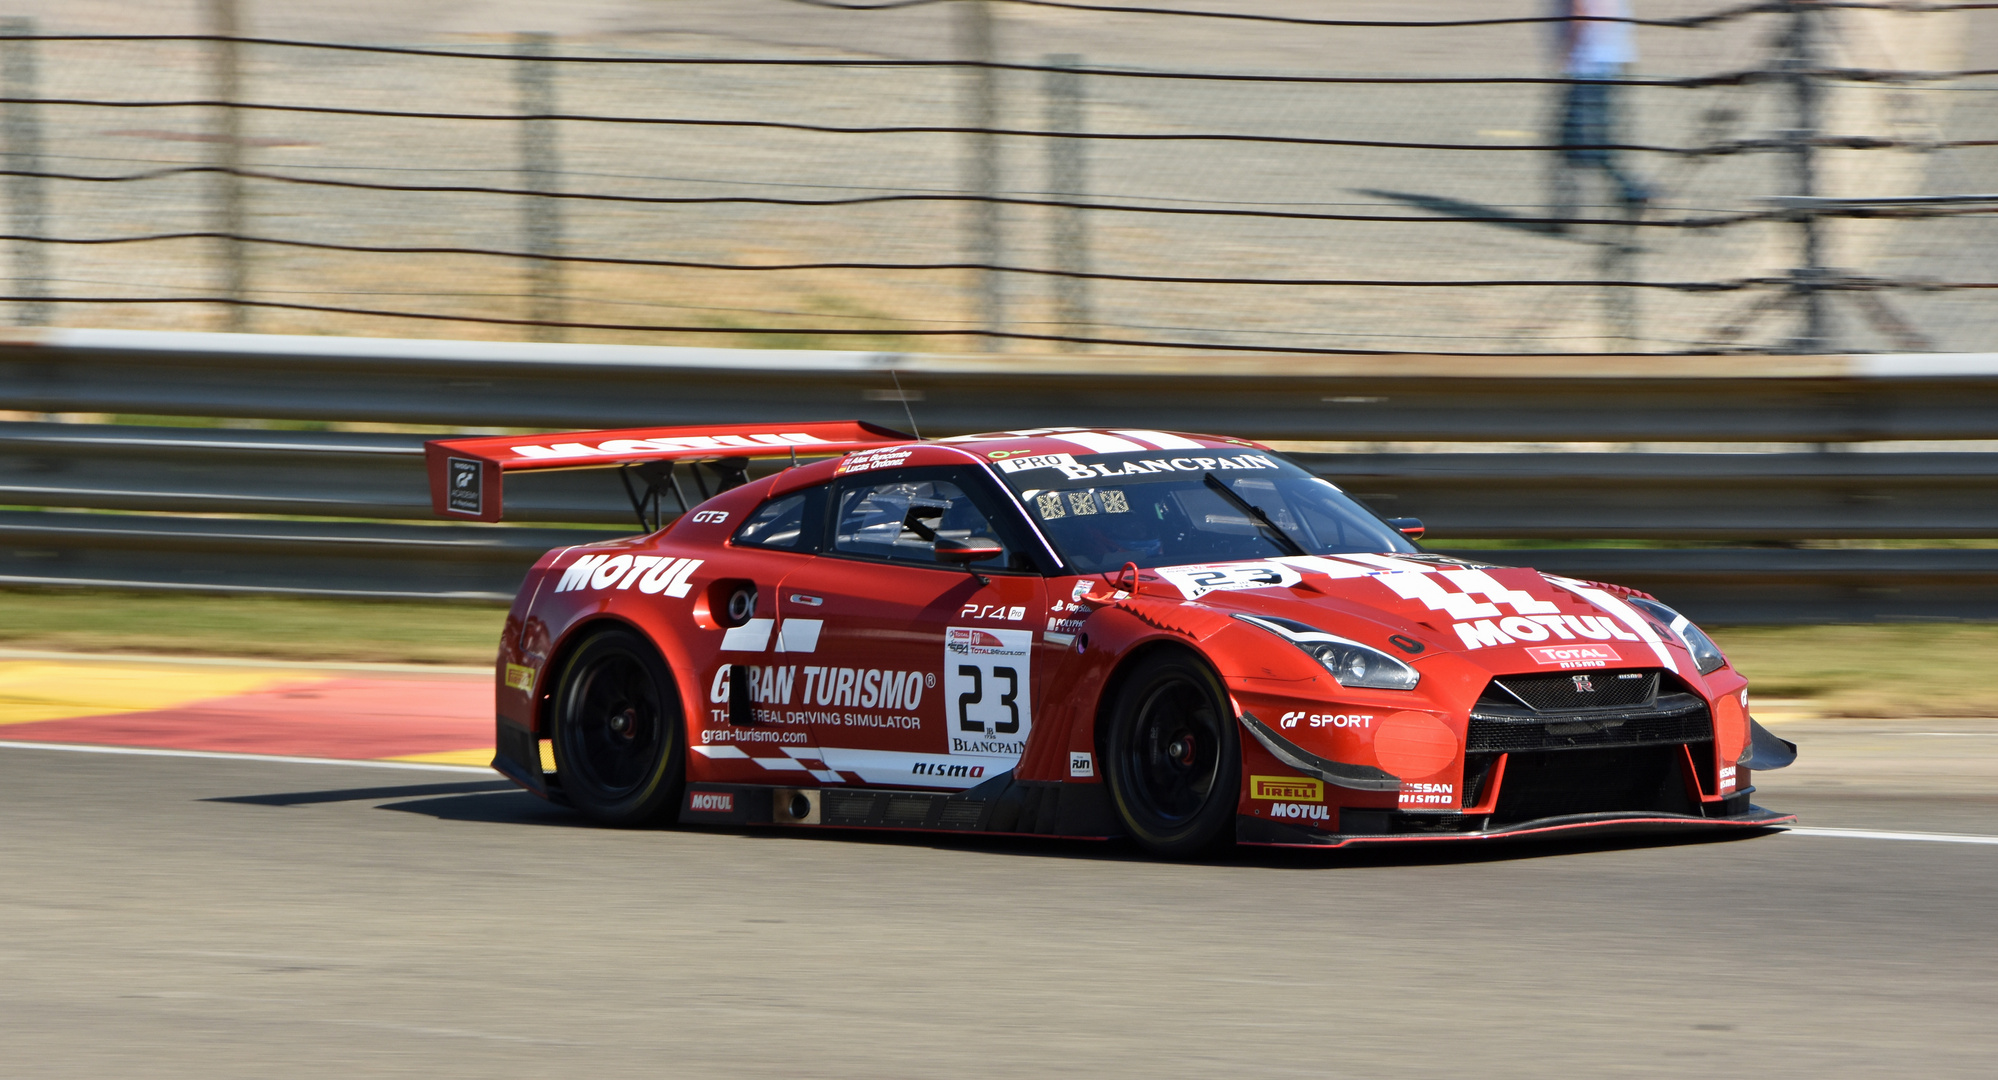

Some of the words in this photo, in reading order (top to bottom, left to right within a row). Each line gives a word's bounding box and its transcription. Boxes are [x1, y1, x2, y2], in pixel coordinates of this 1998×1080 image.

[845, 463, 870, 473] Lucas
[1011, 455, 1062, 470] PRO
[1052, 454, 1280, 480] BLANCPAIN
[692, 510, 729, 524] GT3
[554, 554, 705, 599] MOTUL
[1187, 568, 1283, 587] 23
[1452, 615, 1640, 650] MOTUL
[1540, 648, 1608, 660] TOTAL
[1560, 661, 1606, 669] nismo
[803, 666, 924, 711] TURISMO
[958, 664, 1020, 734] 23
[757, 709, 785, 723] REAL
[786, 711, 841, 725] DRIVING
[844, 713, 921, 729] SIMULATOR
[1309, 714, 1374, 728] SPORT
[701, 728, 808, 744] gran-turismo.com
[912, 763, 985, 777] nismo
[1257, 781, 1317, 798] PIRELLI
[691, 794, 732, 810] MOTUL
[1398, 794, 1453, 804] nismo
[1271, 803, 1330, 820] MOTUL
